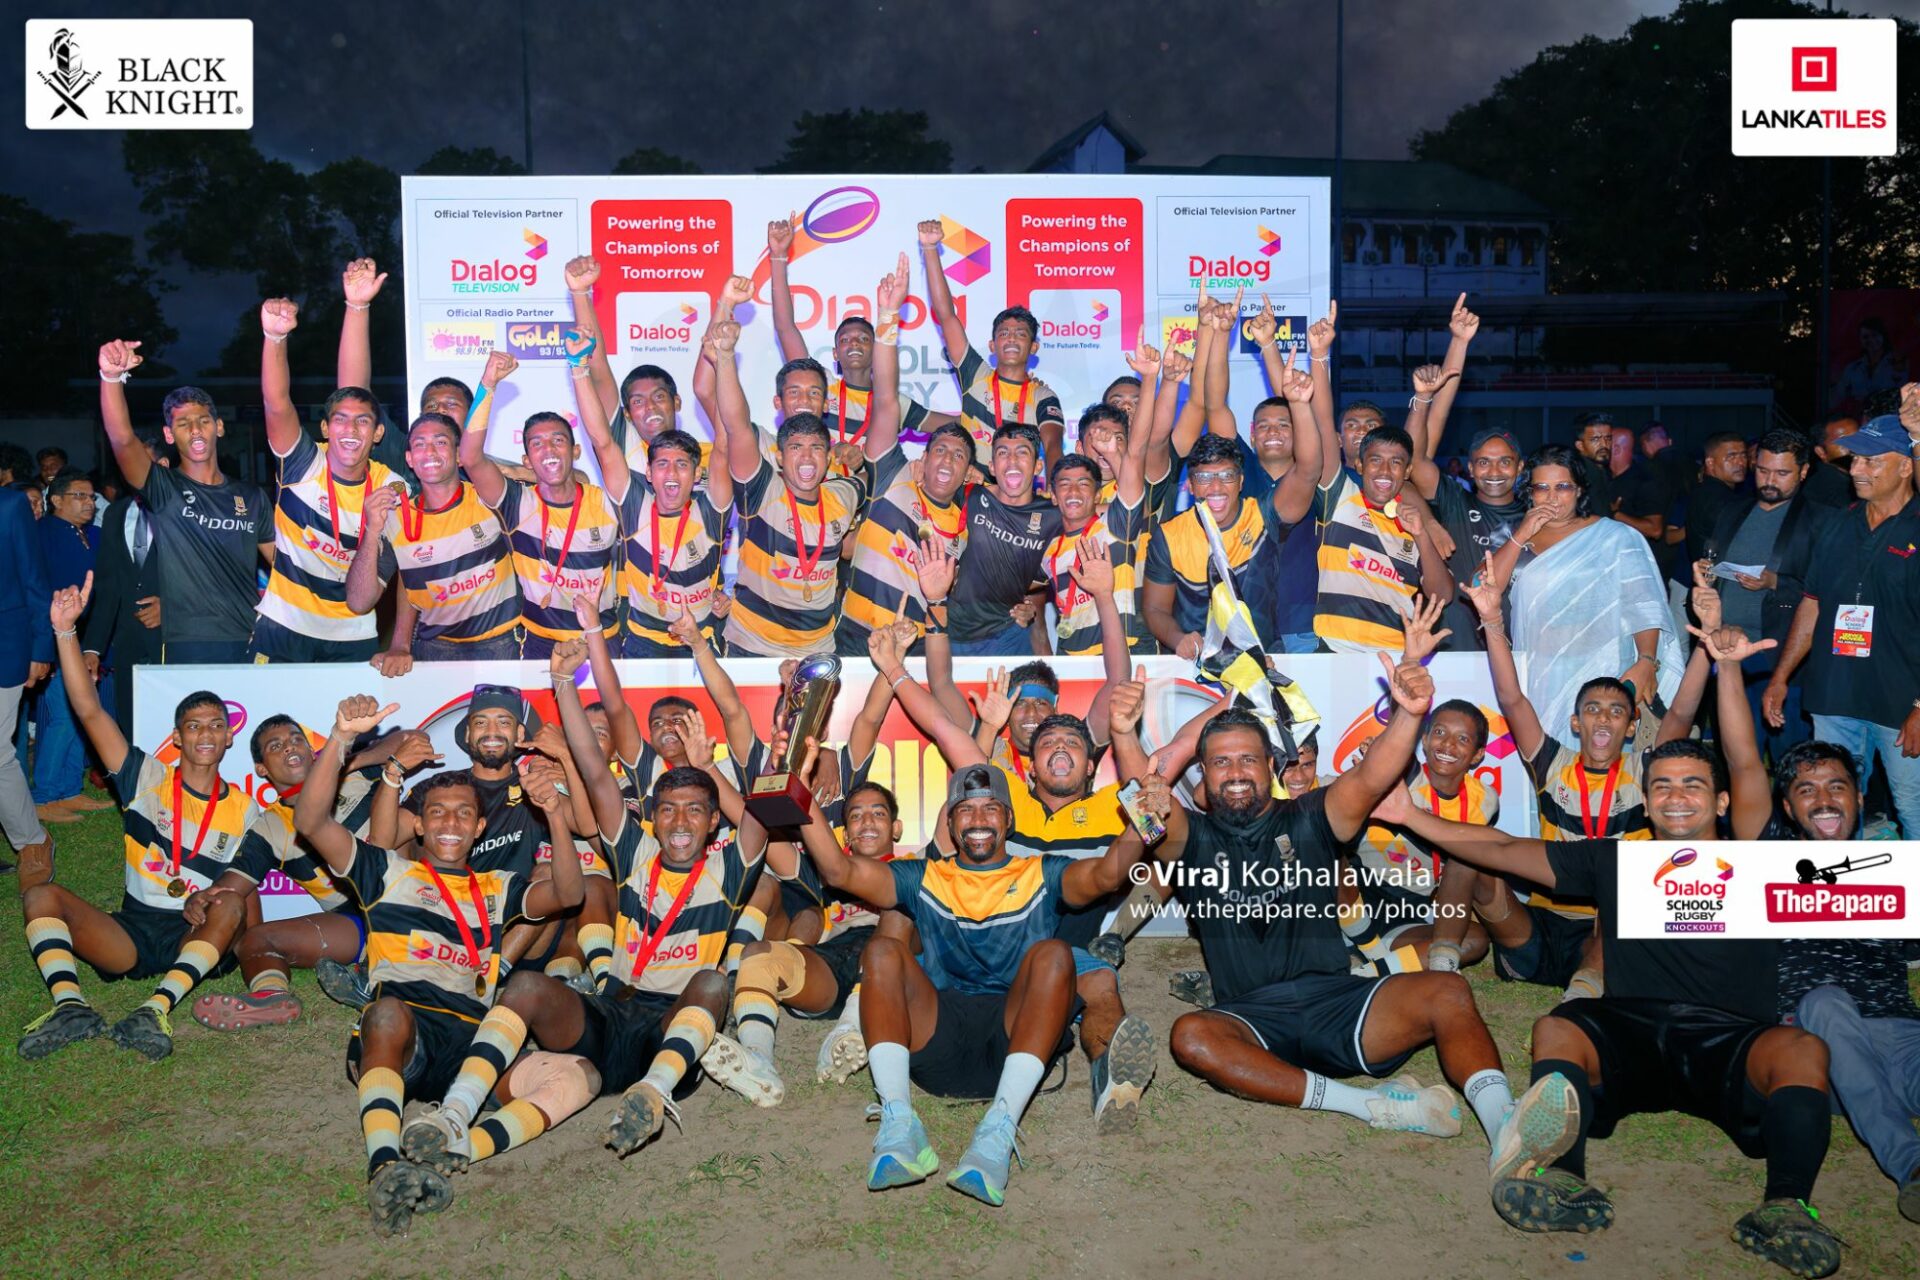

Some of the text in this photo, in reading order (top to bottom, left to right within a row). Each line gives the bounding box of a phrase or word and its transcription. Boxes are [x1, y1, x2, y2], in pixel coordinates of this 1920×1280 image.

[434, 209, 563, 218] Official Television Partner
[1174, 206, 1296, 216] Official Television Partner
[607, 216, 716, 232] Powering the
[1021, 214, 1127, 229] Powering the
[605, 241, 719, 256] Champions of
[1019, 238, 1130, 254] Champions of
[451, 259, 537, 286] Dialog
[620, 266, 704, 279] Tomorrow
[1034, 264, 1115, 277] Tomorrow
[1189, 255, 1271, 282] Dialog
[452, 283, 520, 293] TELEVISION
[446, 308, 554, 318] Official Radio Partner
[629, 323, 690, 343] Dialog
[1042, 320, 1102, 340] Dialog
[630, 345, 643, 353] The
